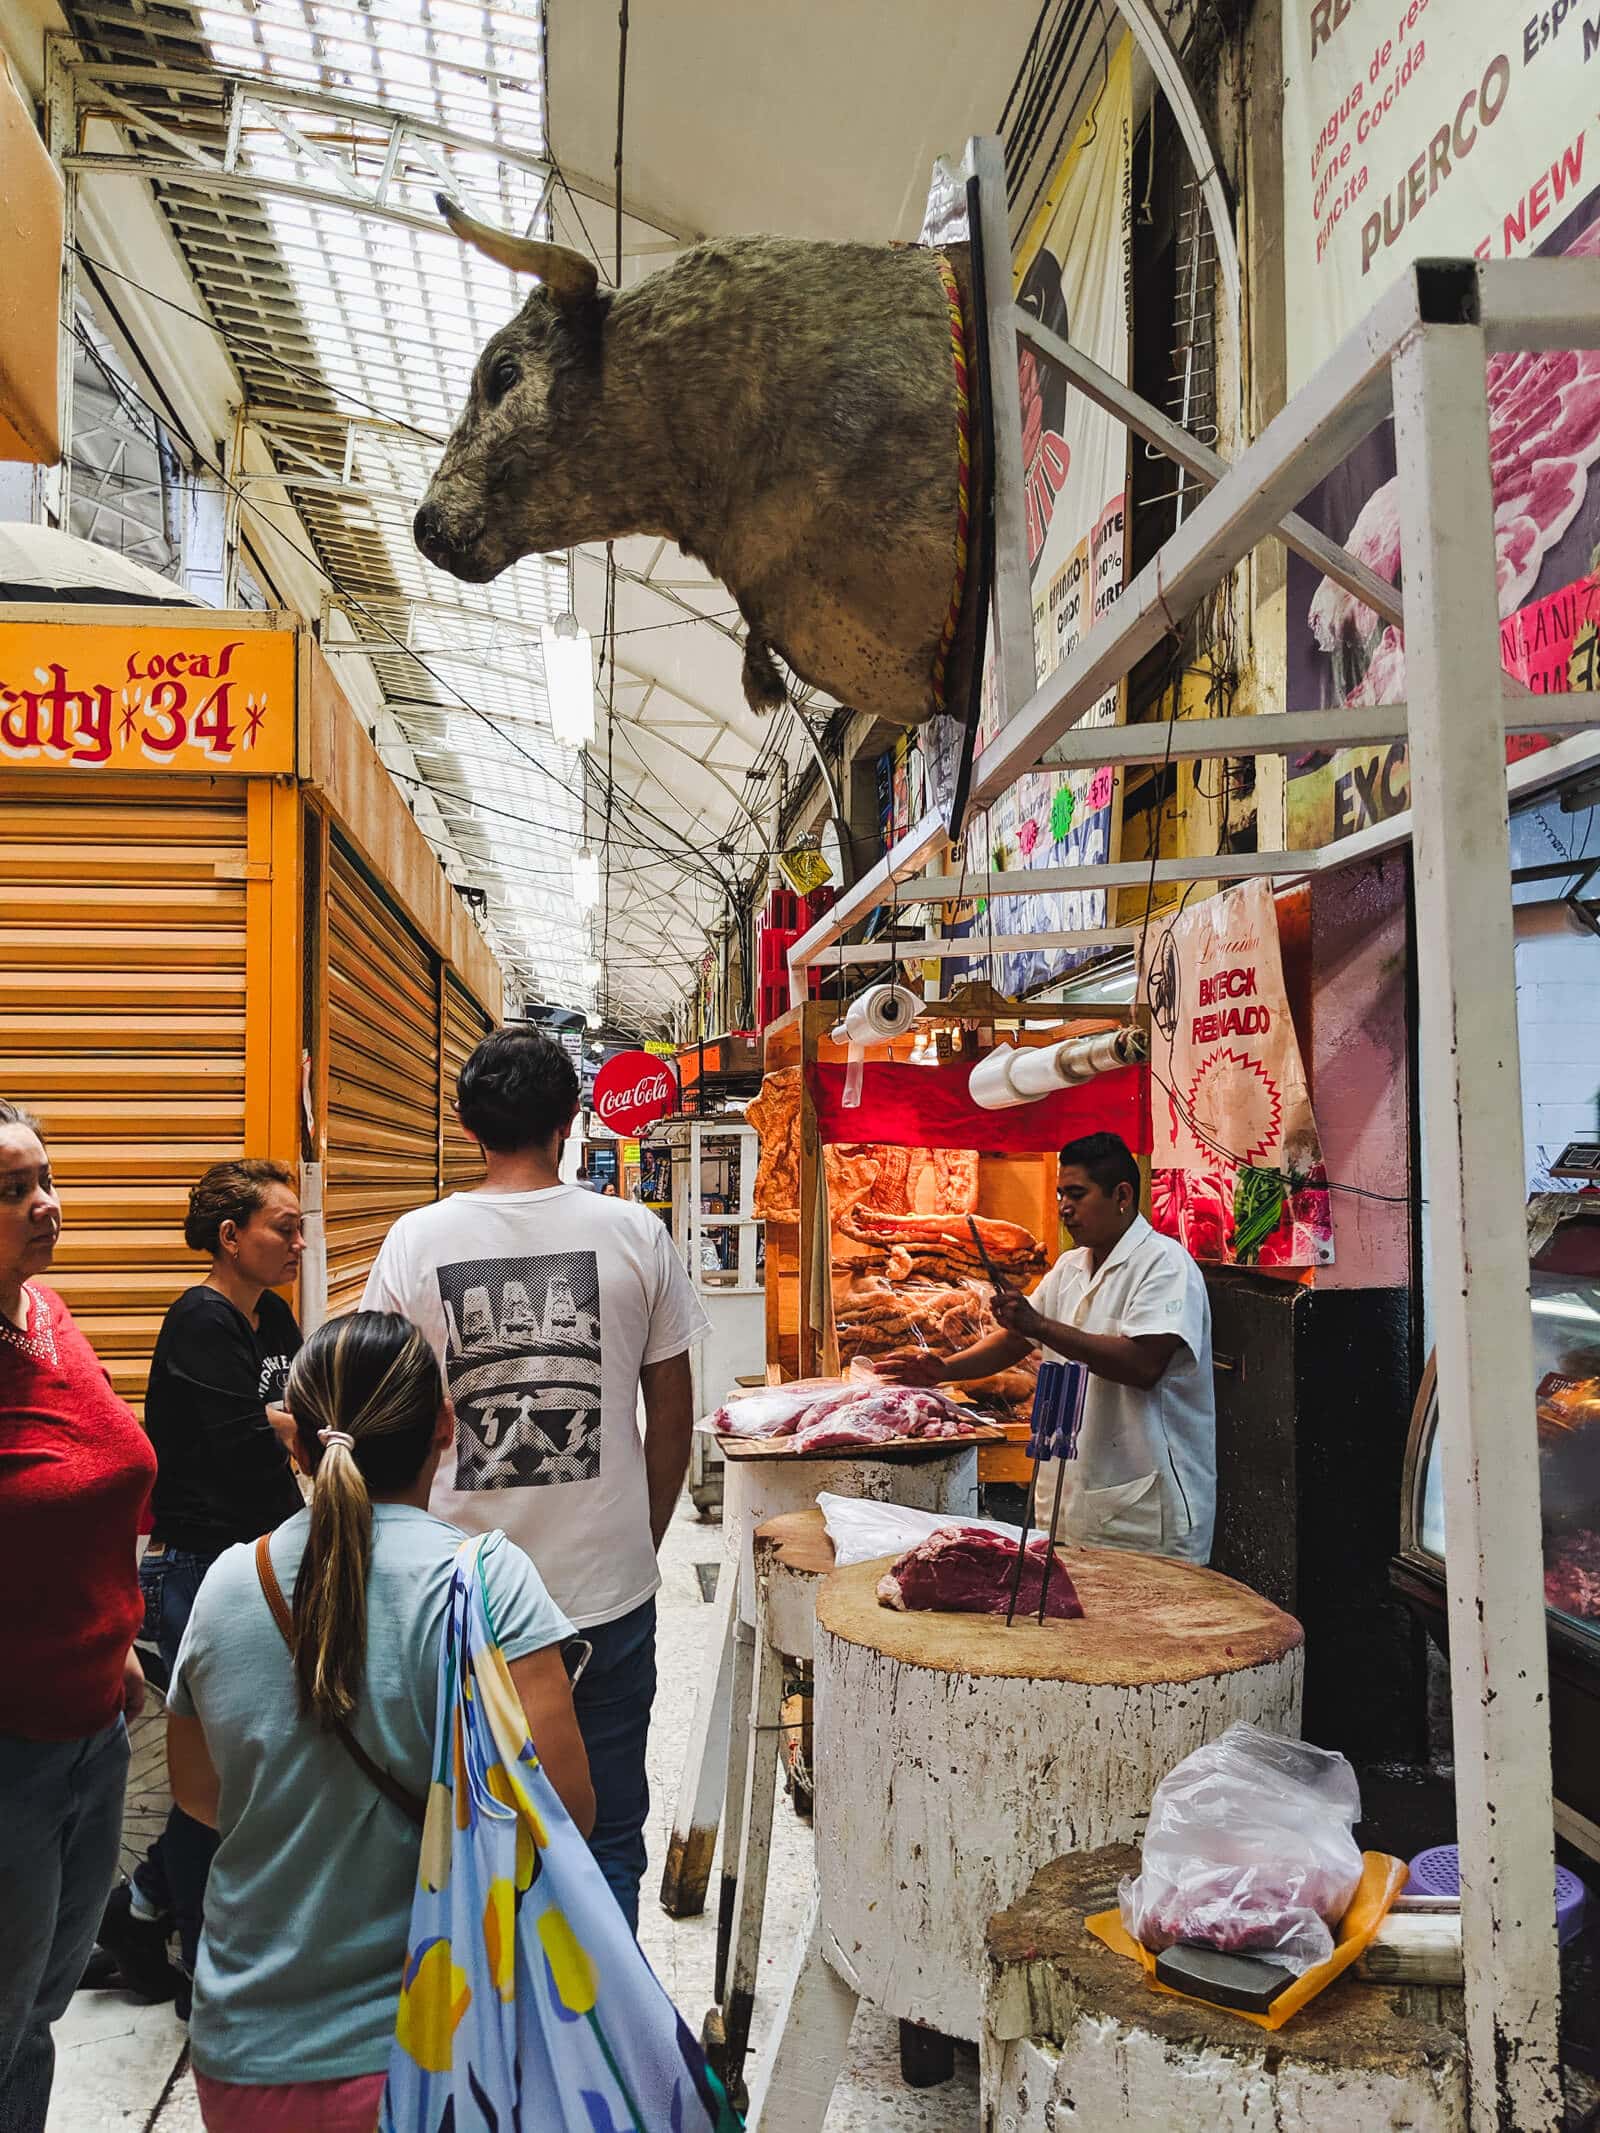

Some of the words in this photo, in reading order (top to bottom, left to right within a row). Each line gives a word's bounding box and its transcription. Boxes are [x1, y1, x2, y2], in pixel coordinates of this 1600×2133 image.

[1357, 39, 1425, 145] Cocida
[1369, 39, 1392, 85] de
[1361, 54, 1510, 277] PUERCO
[1503, 130, 1585, 257] NEW
[126, 642, 245, 683] Local
[600, 1071, 668, 1118] Coca-Cola
